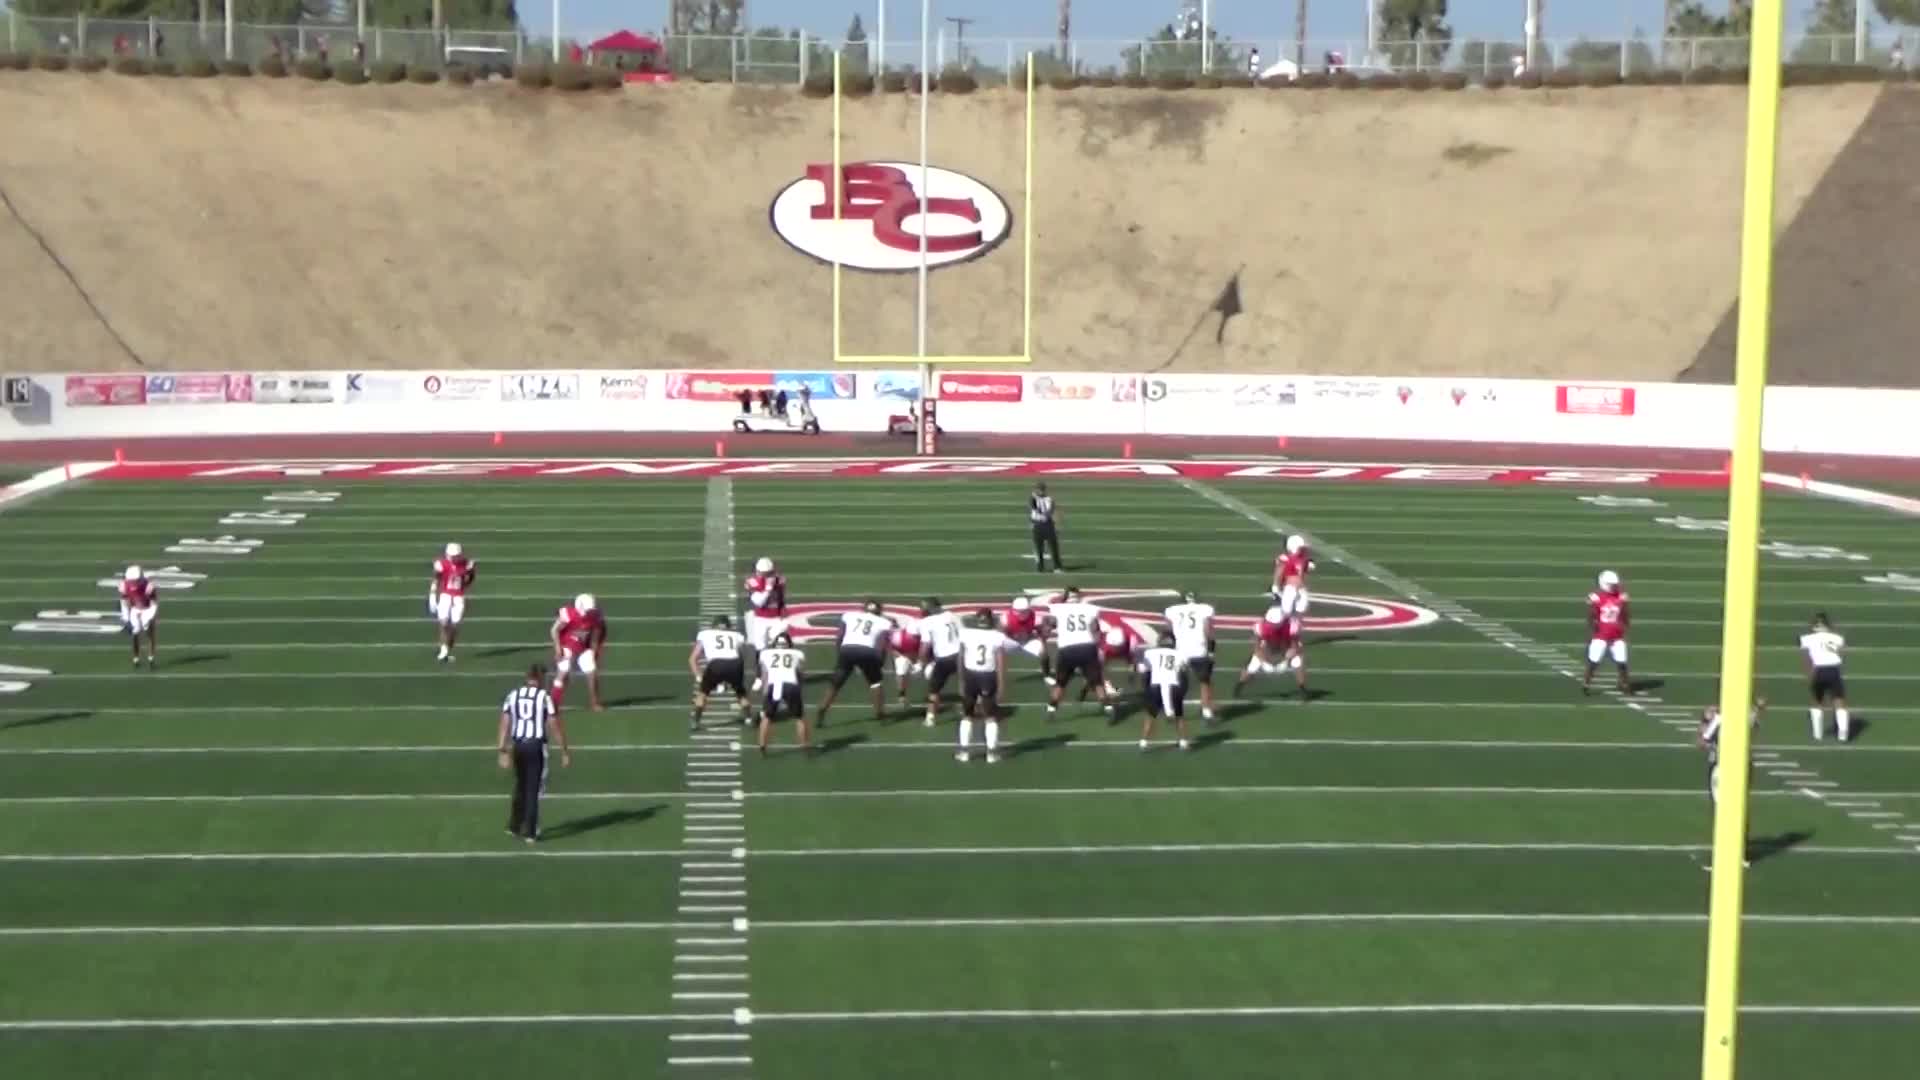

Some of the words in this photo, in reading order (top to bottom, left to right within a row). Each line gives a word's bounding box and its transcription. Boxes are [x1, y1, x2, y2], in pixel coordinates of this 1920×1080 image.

[806, 163, 982, 252] BC
[715, 635, 735, 650] 51
[771, 654, 793, 668] 20
[976, 644, 987, 665] 3
